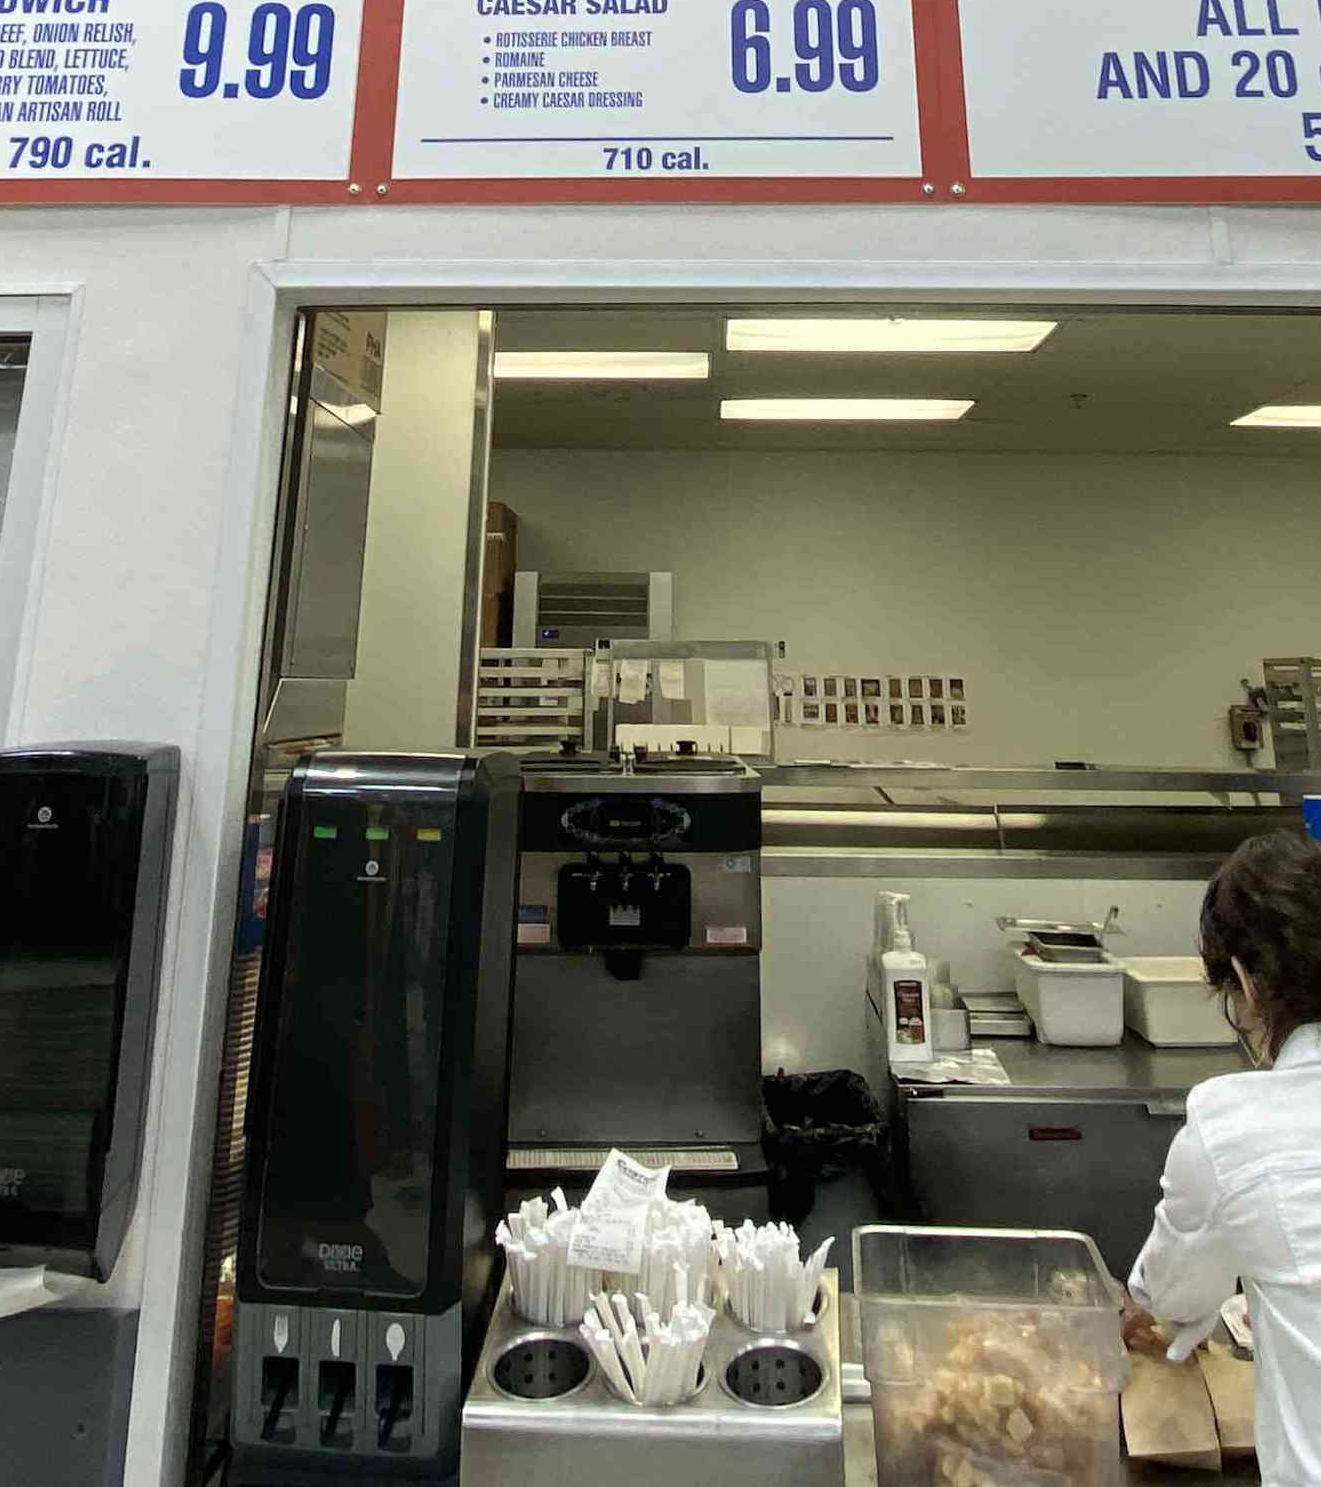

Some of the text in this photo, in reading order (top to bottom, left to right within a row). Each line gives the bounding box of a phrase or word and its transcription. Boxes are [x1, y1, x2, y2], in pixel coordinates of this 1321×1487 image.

[33, 23, 80, 44] ONION
[82, 22, 137, 45] RELISH,
[496, 31, 652, 48] ROTISSERIE CHICKEN BREAST
[8, 48, 59, 72] BLEND,
[64, 48, 130, 71] LETTUCE,
[178, 1, 336, 100] 9.99
[495, 52, 545, 67] ROMAINE
[27, 74, 109, 98] TOMATOES,
[494, 71, 599, 88] PARMESAN CHEESE
[1096, 50, 1211, 100] AND
[1231, 49, 1299, 99] 20
[17, 101, 82, 122] ARTISAN
[86, 100, 122, 122] ROLL
[493, 91, 643, 108] CREAMY CAESAR DRESSING
[8, 136, 152, 170] 790 cal.
[602, 147, 710, 171] 710 cal.
